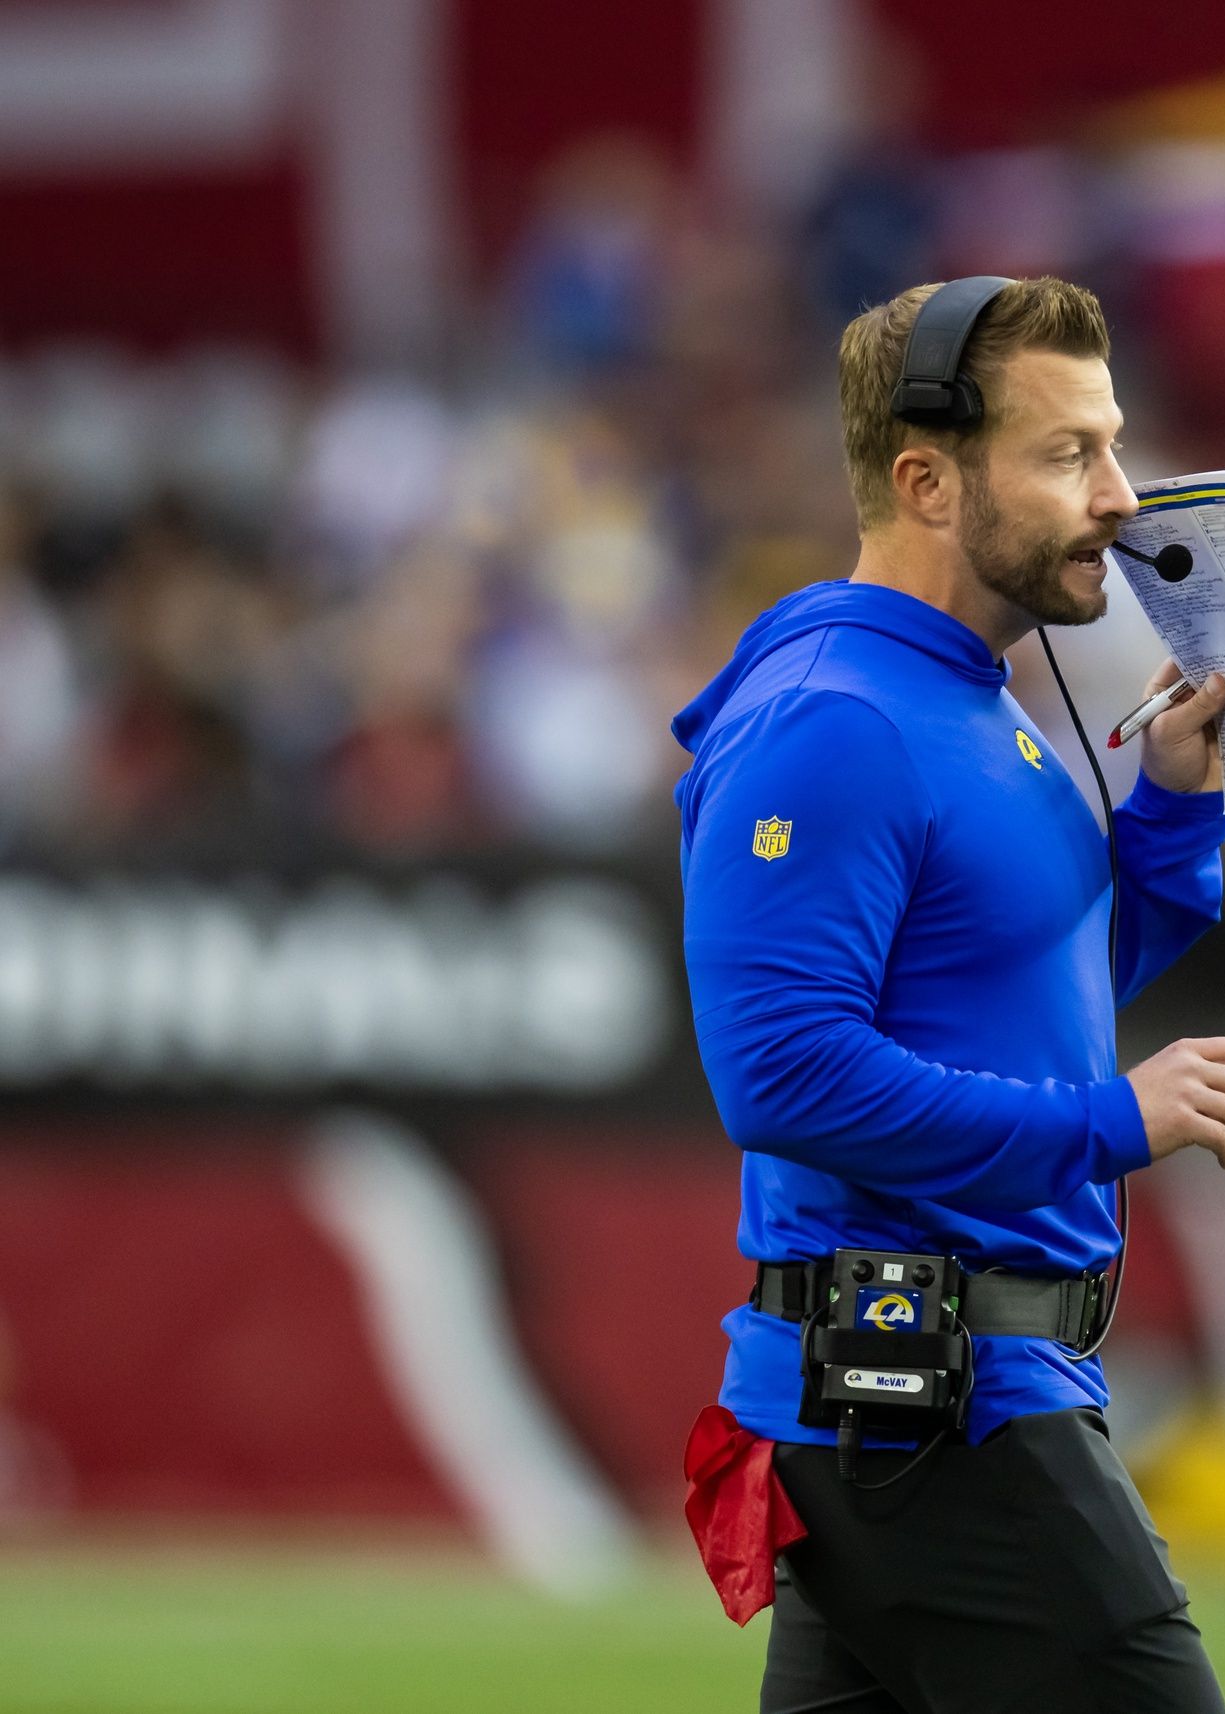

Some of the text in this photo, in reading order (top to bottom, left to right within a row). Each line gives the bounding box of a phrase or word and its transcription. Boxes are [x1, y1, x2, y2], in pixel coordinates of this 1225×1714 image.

[758, 835, 785, 855] NFL
[863, 1294, 915, 1325] LA
[876, 1376, 908, 1388] McVAY
